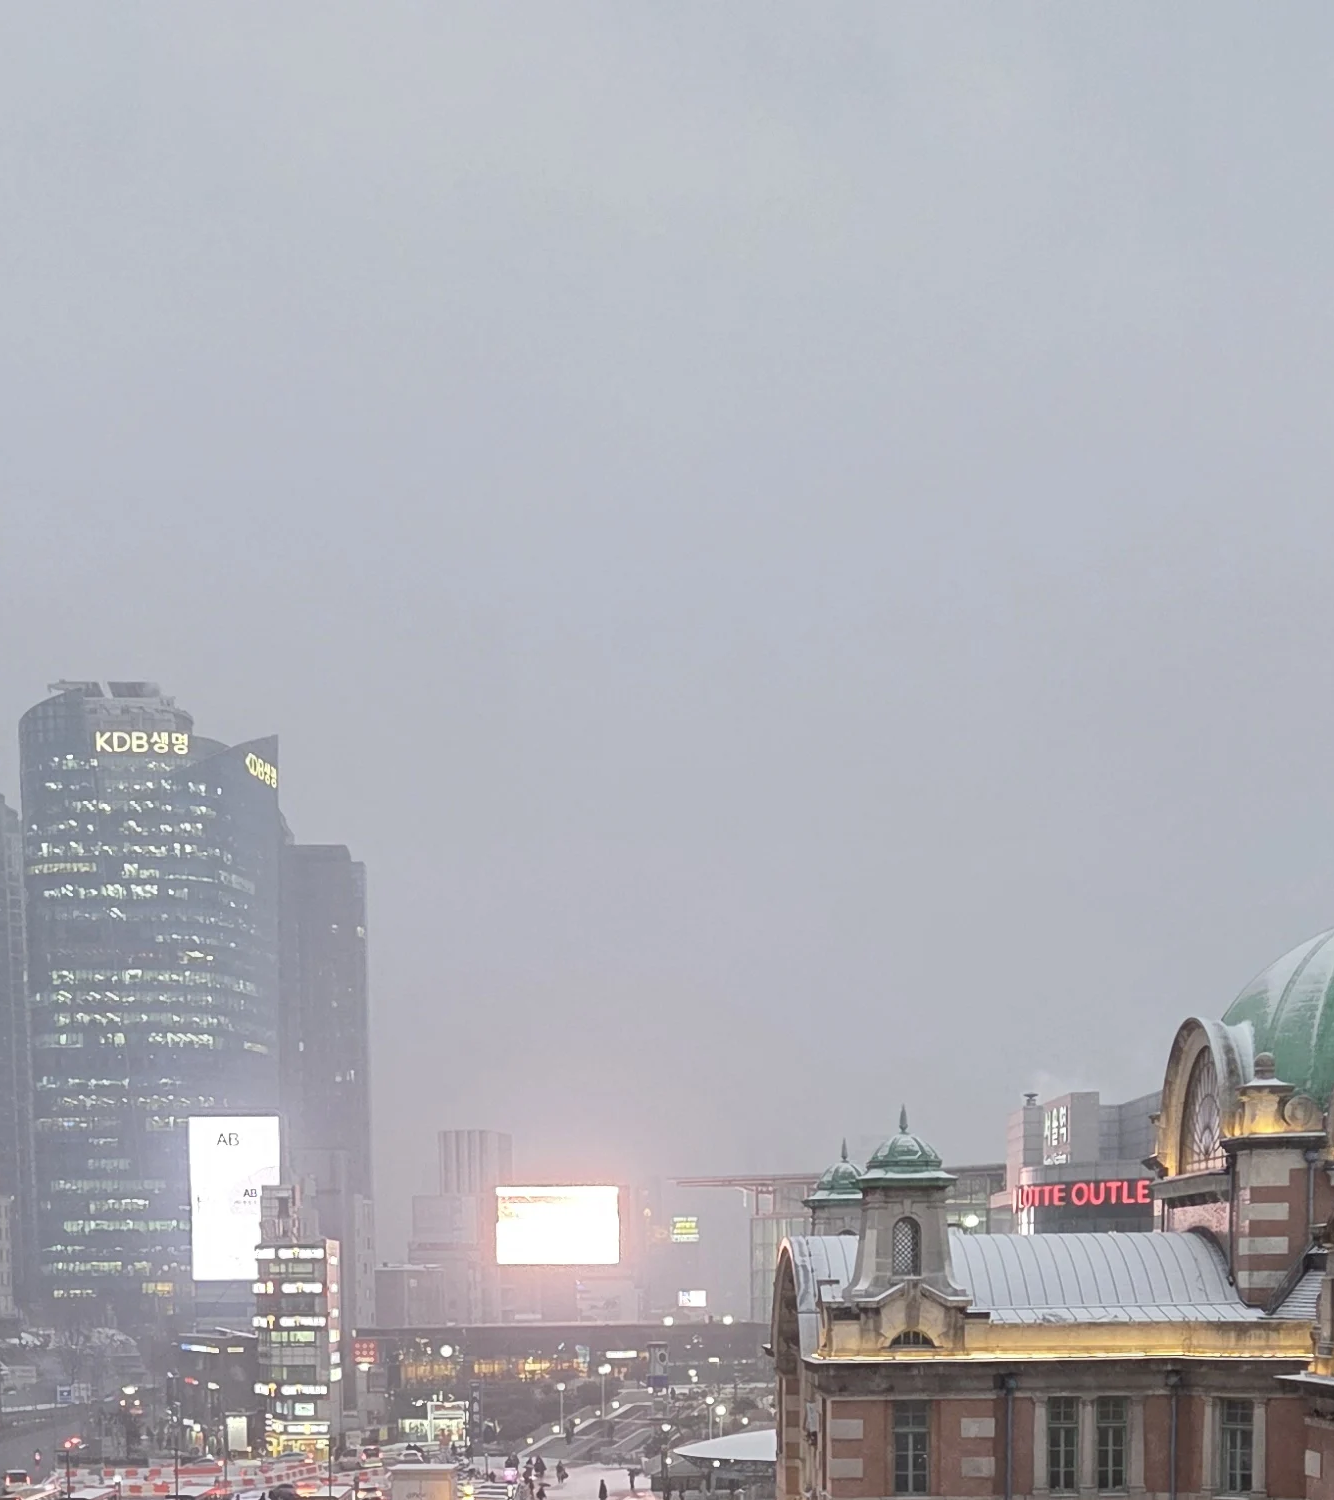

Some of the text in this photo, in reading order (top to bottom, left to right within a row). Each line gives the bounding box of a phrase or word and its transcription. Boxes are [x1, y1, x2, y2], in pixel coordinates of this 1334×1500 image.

[95, 731, 189, 755] KDB생명
[1018, 1180, 1151, 1208] LOTTE OUTLE
